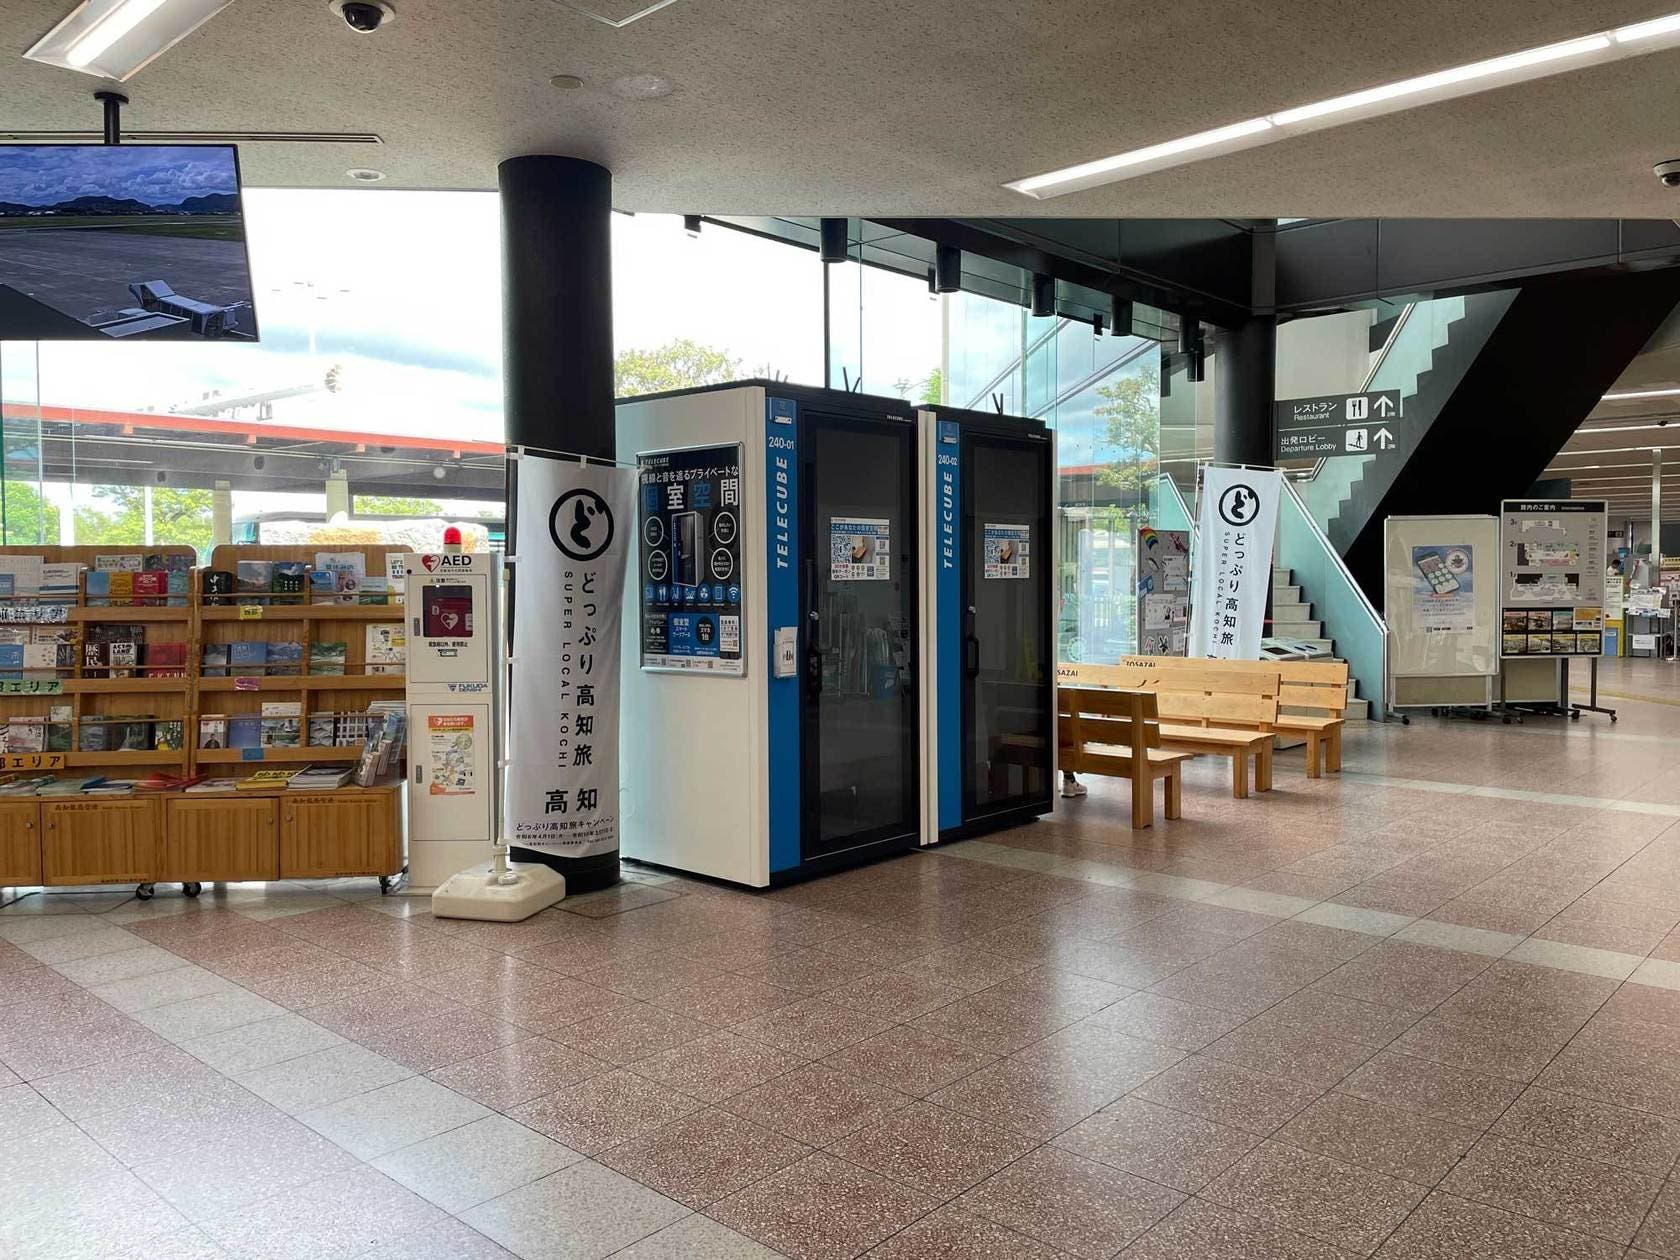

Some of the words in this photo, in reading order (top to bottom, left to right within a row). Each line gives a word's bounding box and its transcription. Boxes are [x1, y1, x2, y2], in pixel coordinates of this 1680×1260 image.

[1294, 402, 1337, 414] レストラン
[1294, 411, 1330, 421] Restaurant
[768, 436, 795, 450] 240-01
[1281, 433, 1326, 445] 出発ロビー
[1281, 445, 1314, 453] Departure
[1315, 443, 1336, 451] Lobby
[938, 454, 958, 465] 240-02
[776, 456, 788, 569] TELECUBE
[943, 471, 953, 569] TELECUBE
[441, 555, 472, 566] AED
[1220, 531, 1231, 566] SUPER
[563, 571, 573, 629] SUPER
[1215, 571, 1226, 606] LOCAL
[1212, 611, 1221, 645] KOCHI
[560, 642, 571, 700] LOCAL
[558, 712, 569, 768] KOCHI
[545, 788, 598, 814] 高知
